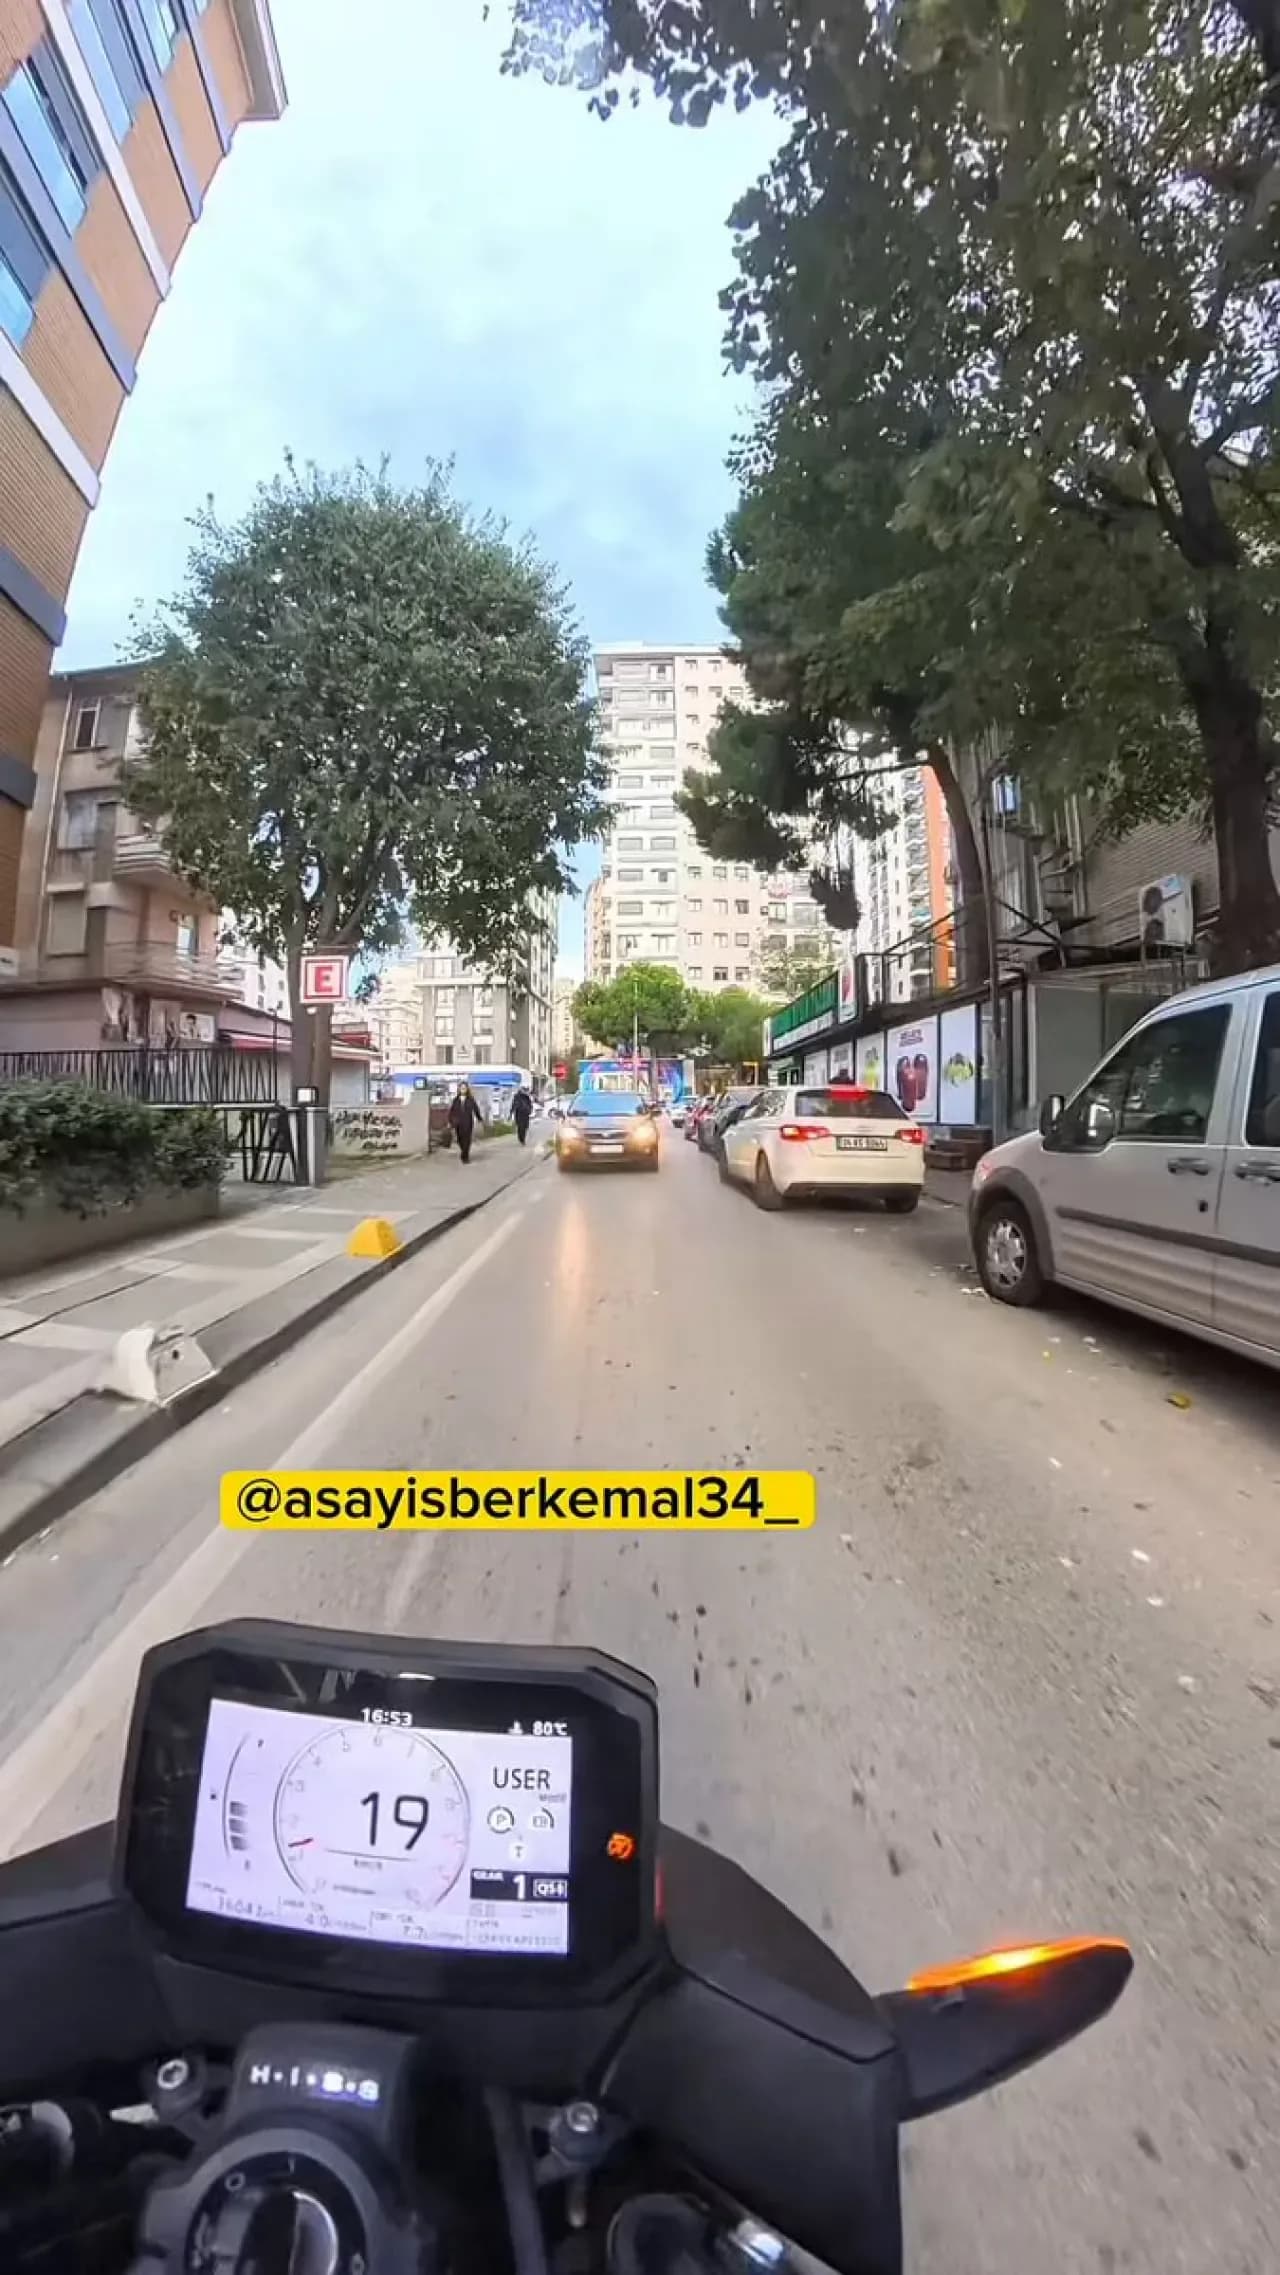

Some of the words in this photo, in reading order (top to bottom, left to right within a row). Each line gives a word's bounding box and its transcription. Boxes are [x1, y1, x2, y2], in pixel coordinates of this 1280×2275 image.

[314, 965, 333, 993] E
[361, 1707, 413, 1727] 16:53
[492, 1766, 551, 1791] USER
[360, 1791, 429, 1851] 19
[512, 1873, 527, 1900] 1
